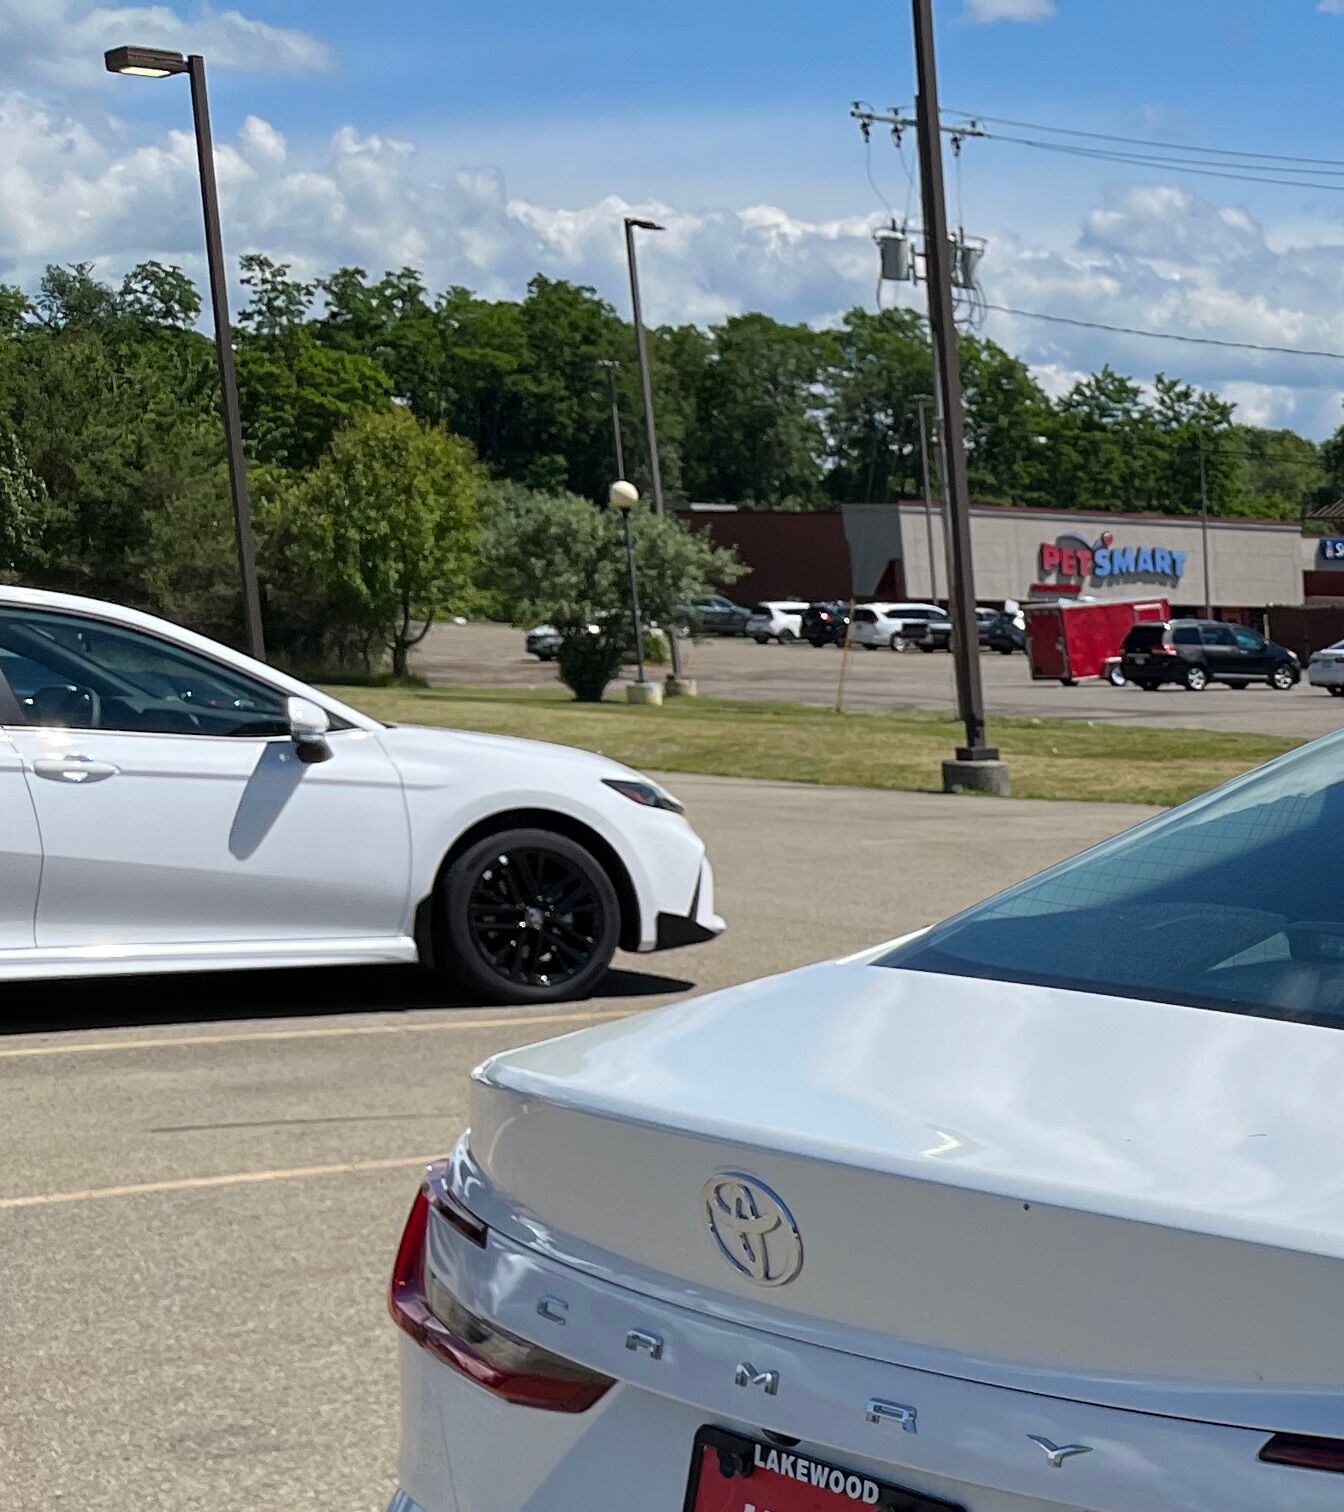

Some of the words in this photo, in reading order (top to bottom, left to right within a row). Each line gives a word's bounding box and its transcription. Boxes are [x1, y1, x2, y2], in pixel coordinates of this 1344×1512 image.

[1040, 542, 1186, 578] PETSMART
[536, 1295, 1094, 1469] CAMRY
[753, 1444, 880, 1504] LAKEWOOD
